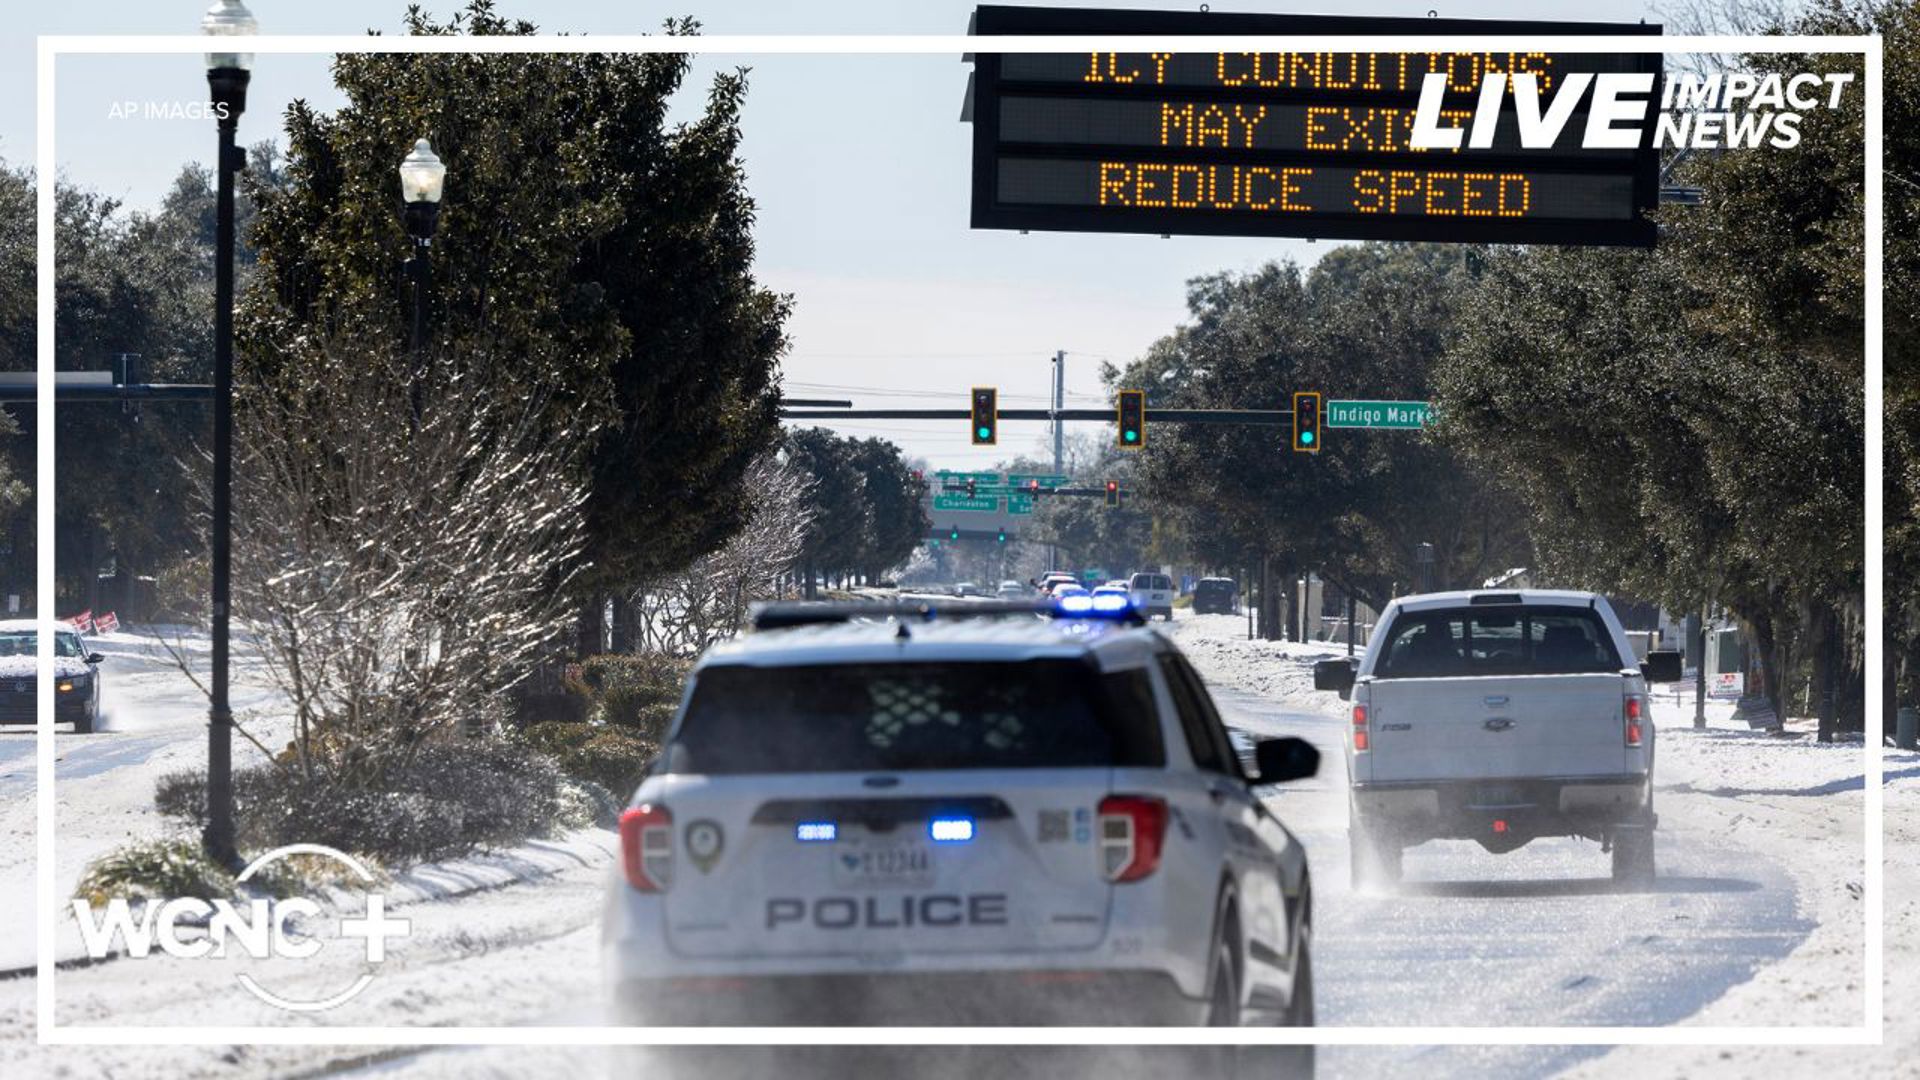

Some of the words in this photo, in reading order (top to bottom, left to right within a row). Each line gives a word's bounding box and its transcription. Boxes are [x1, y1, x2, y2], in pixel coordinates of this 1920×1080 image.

[1084, 50, 1173, 83] ICY
[1161, 103, 1266, 148] MAY
[1101, 163, 1313, 211] REDUCE
[1354, 170, 1530, 217] SPEED
[1332, 406, 1380, 426] Indigo
[765, 894, 1008, 931] POLICE
